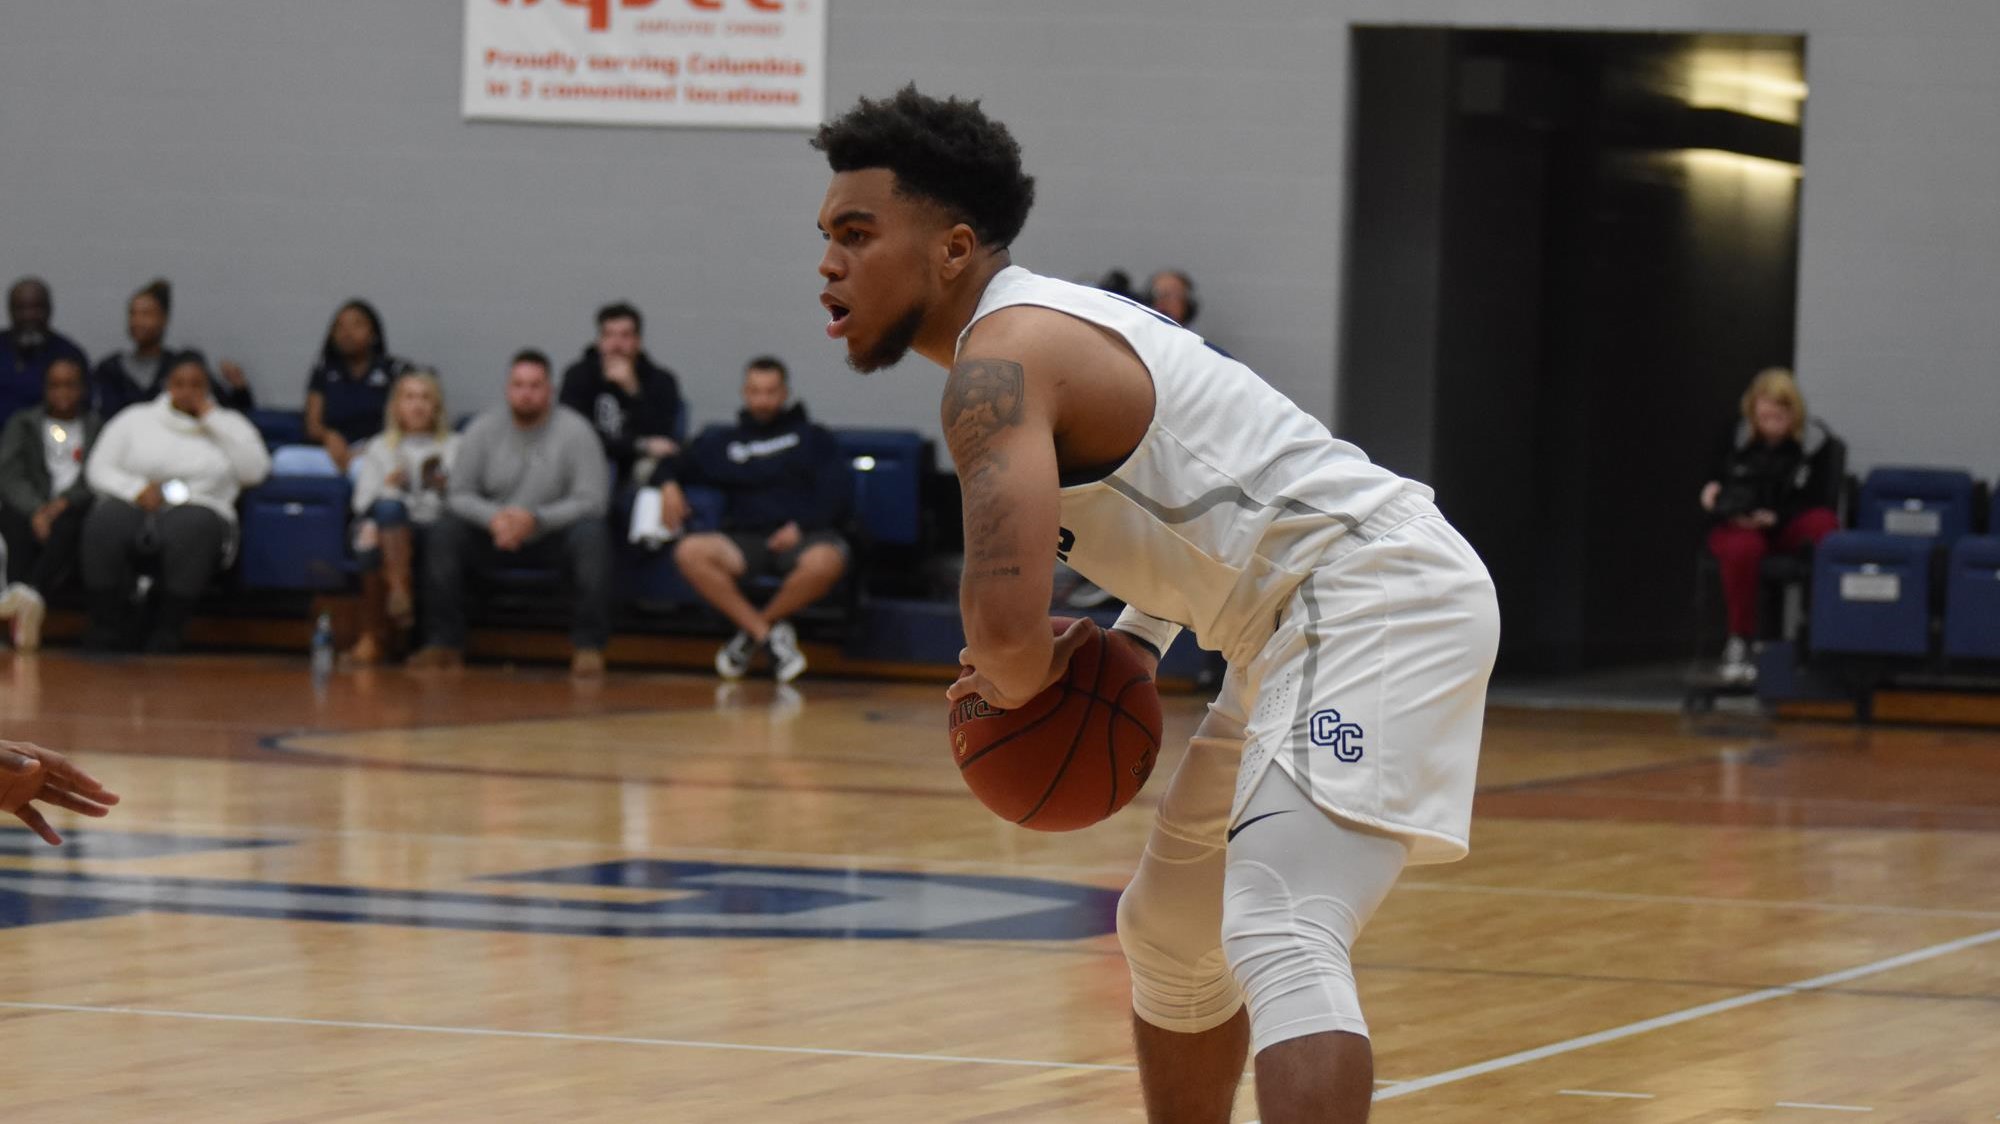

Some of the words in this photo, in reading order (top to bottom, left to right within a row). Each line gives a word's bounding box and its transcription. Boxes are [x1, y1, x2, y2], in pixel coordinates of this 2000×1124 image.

[484, 49, 577, 74] Proudly
[587, 55, 679, 77] serving
[687, 53, 806, 76] Columbia
[485, 80, 510, 97] in
[539, 83, 677, 102] convenient
[684, 85, 801, 105] locations
[1310, 708, 1363, 763] CC
